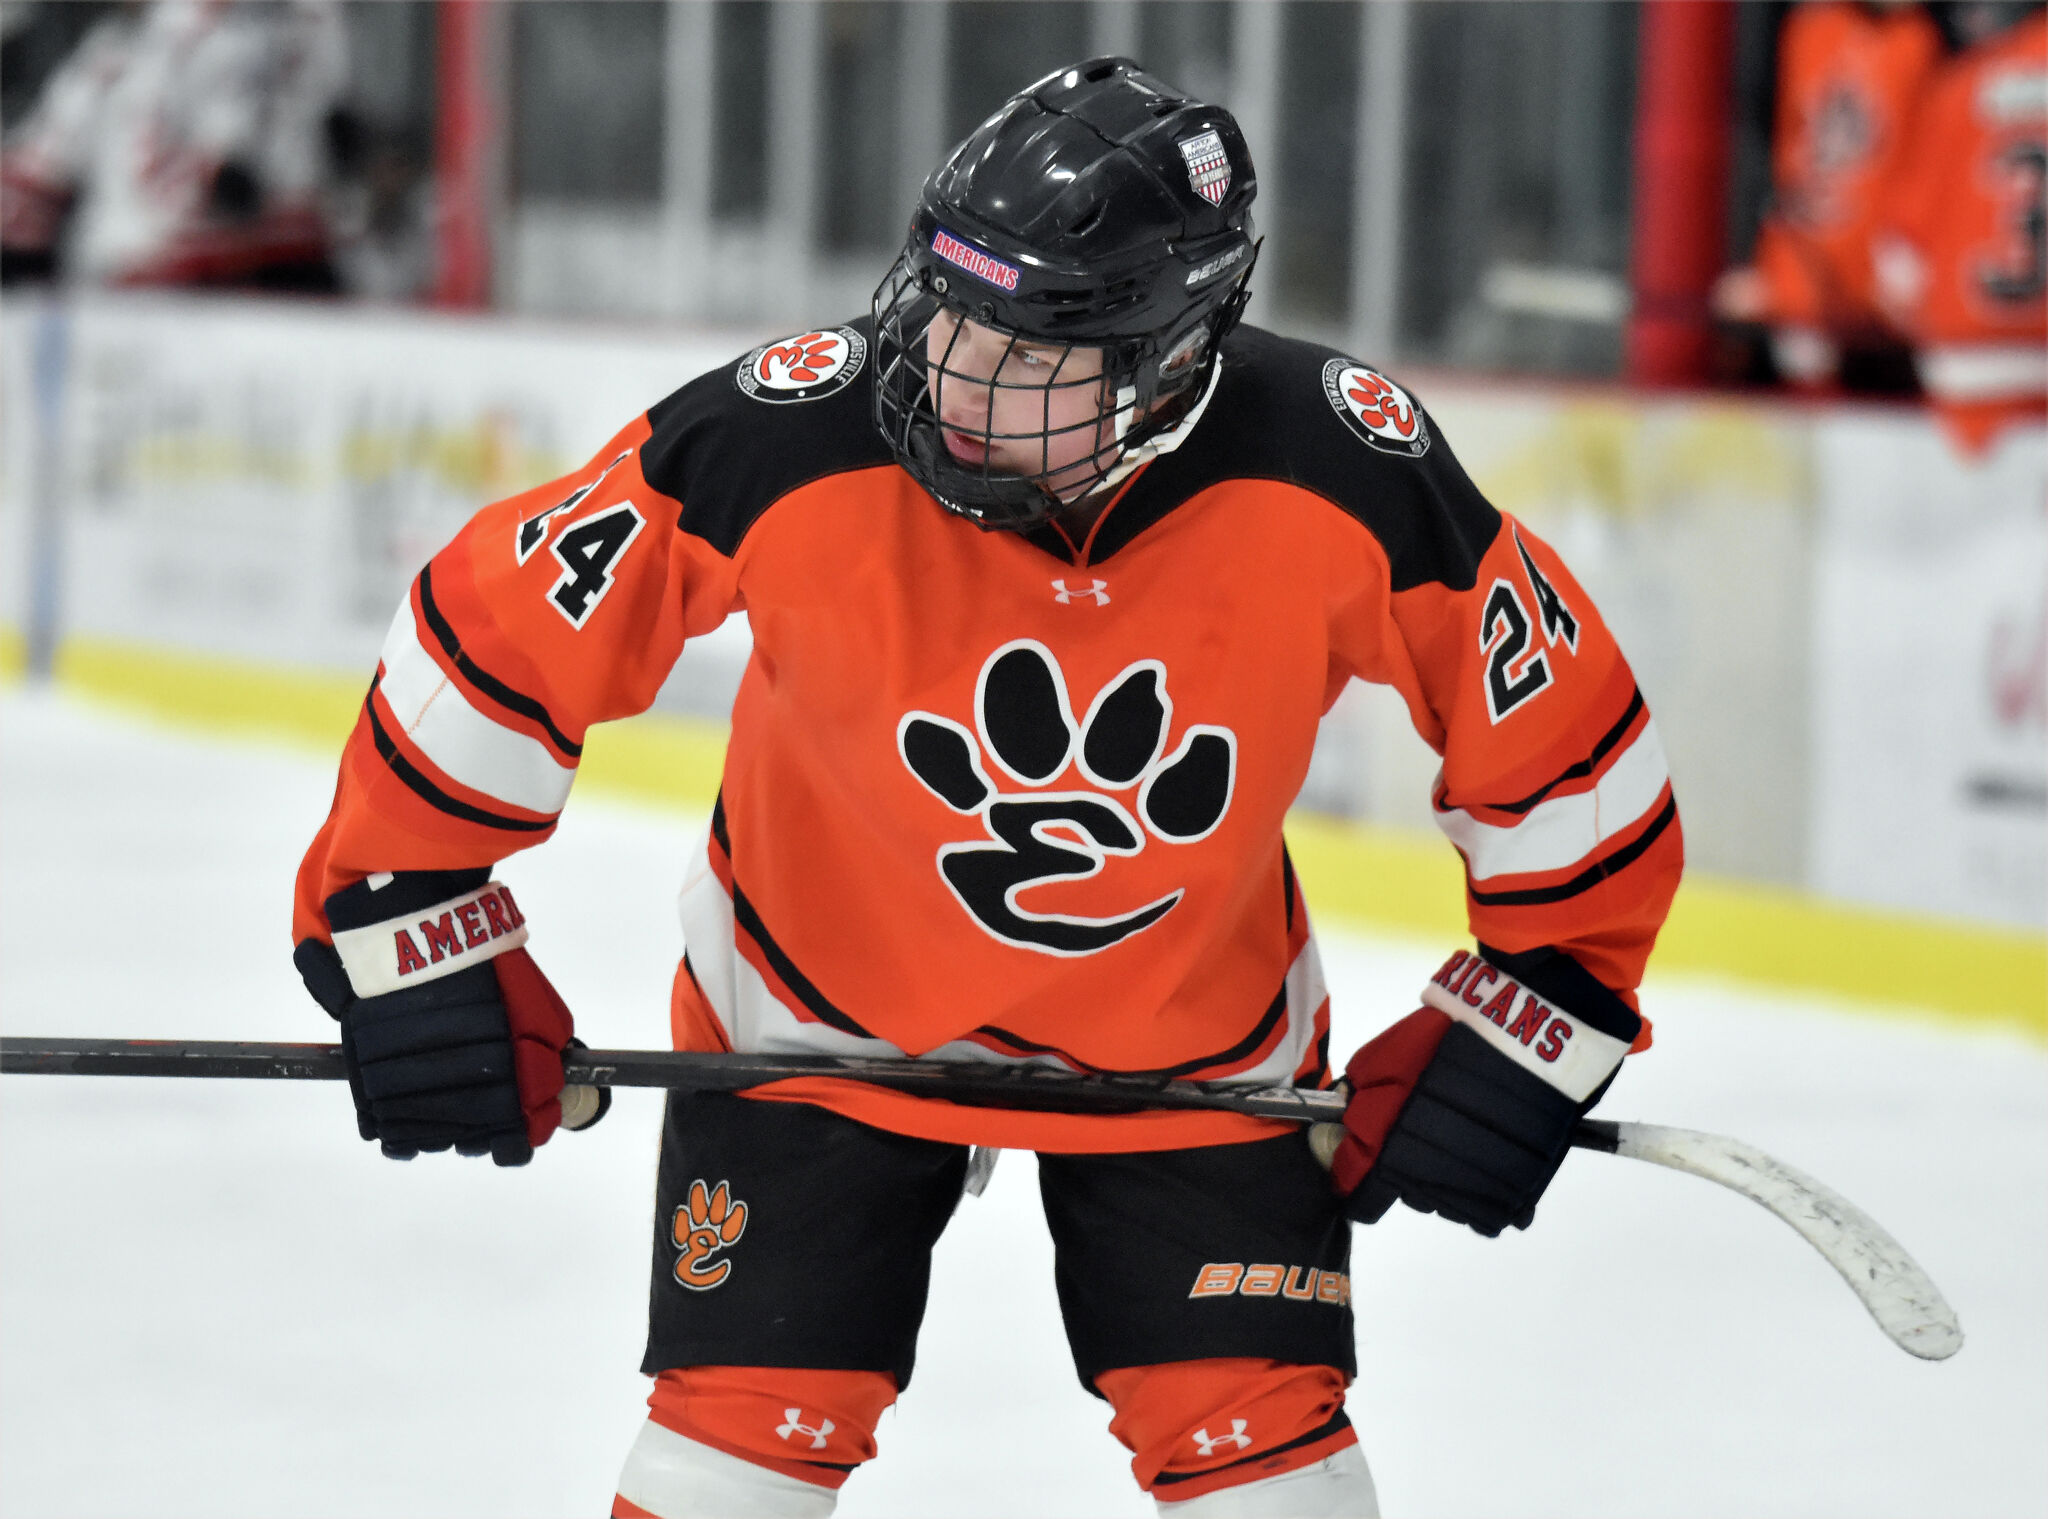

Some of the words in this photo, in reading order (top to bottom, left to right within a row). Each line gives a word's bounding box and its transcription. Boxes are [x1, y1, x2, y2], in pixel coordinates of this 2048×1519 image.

[932, 231, 1019, 291] AMERICANS
[1479, 520, 1580, 727] 24
[1431, 949, 1573, 1063] RICANS
